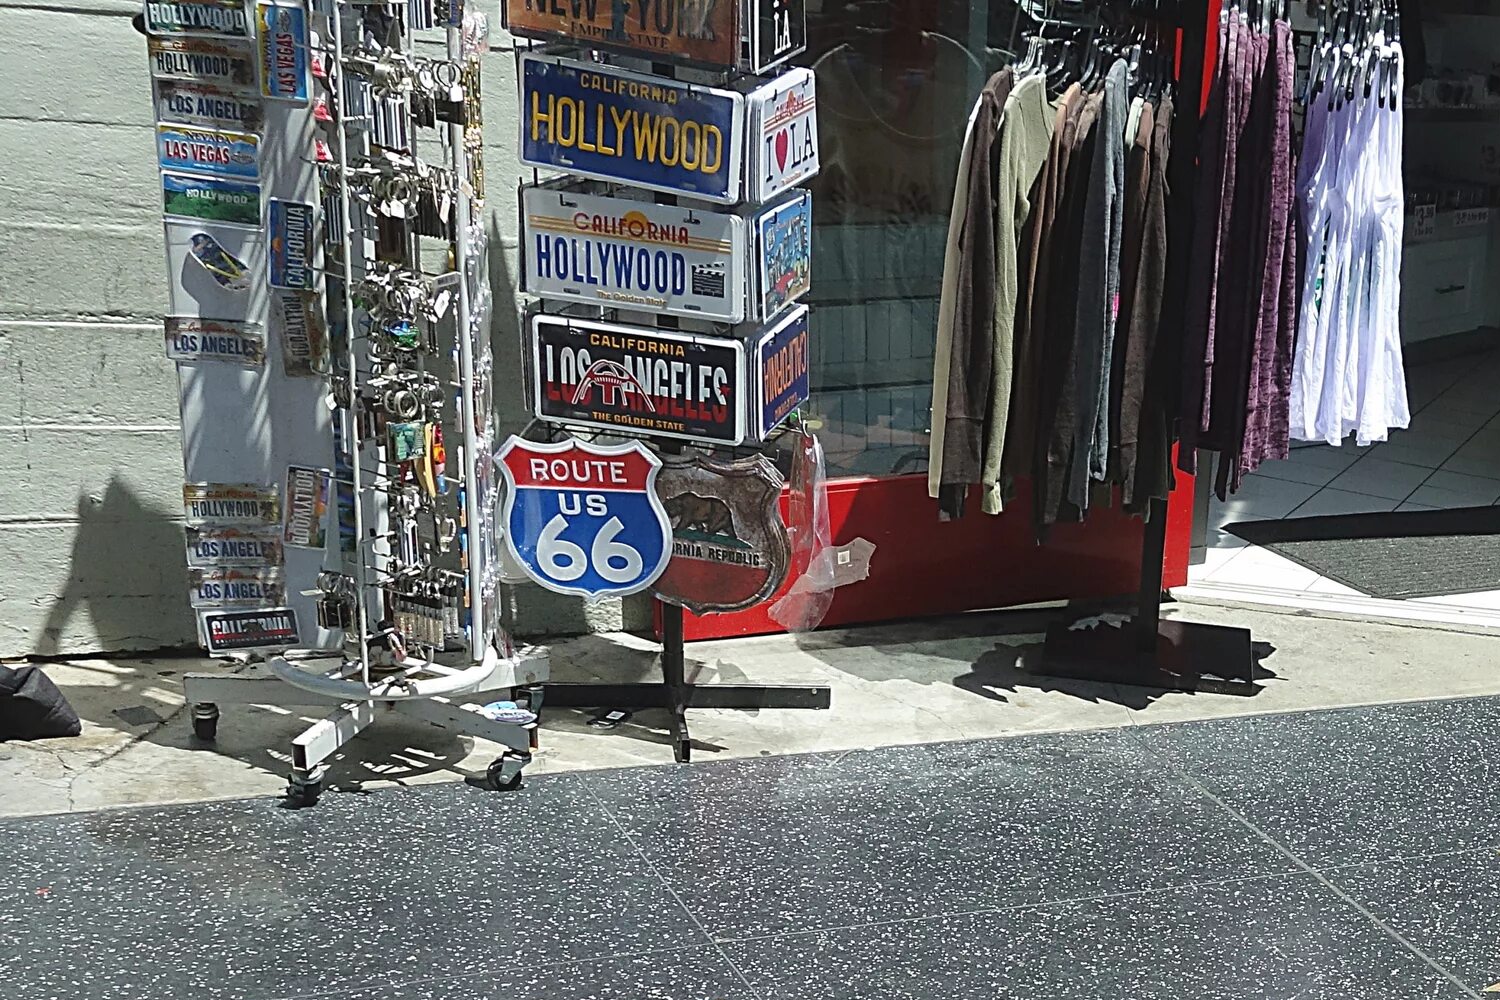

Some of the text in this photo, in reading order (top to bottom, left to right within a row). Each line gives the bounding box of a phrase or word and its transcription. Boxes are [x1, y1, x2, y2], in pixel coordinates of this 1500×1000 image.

[149, 2, 245, 31] HOLLYWOOD
[628, 33, 672, 49] STATE
[773, 9, 792, 56] LA
[157, 51, 229, 76] HOLLYWOOD
[275, 33, 297, 94] LAS VEGAS
[580, 72, 678, 105] CALIFORNIA
[168, 95, 194, 115] LOS
[530, 90, 723, 175] HOLLYWOOD
[165, 139, 231, 165] LAS VEGAS
[765, 116, 815, 183] I LA
[186, 188, 249, 204] HOLLYWOOD
[573, 211, 690, 245] CALIFORNIA
[285, 206, 306, 287] CALIFORNIA
[535, 233, 686, 296] HOLLYWOOD
[613, 292, 645, 304] Golden
[172, 334, 198, 352] LOS
[590, 333, 686, 357] CALIFORNIA
[763, 330, 807, 406] CALIFORNIA
[545, 344, 594, 406] LOS
[620, 354, 729, 424] ANGELES
[592, 411, 685, 432] THE GOLDEN STATE
[529, 458, 628, 484] ROUTE
[192, 499, 259, 518] HOLLYWOOD
[292, 469, 315, 545] HOLLYWOOD
[558, 492, 608, 517] US
[195, 541, 219, 558] LOS
[536, 513, 643, 583] 66
[708, 546, 760, 566] REPUBLIC
[198, 583, 221, 599] LOS
[211, 616, 292, 635] CALIRNIA
